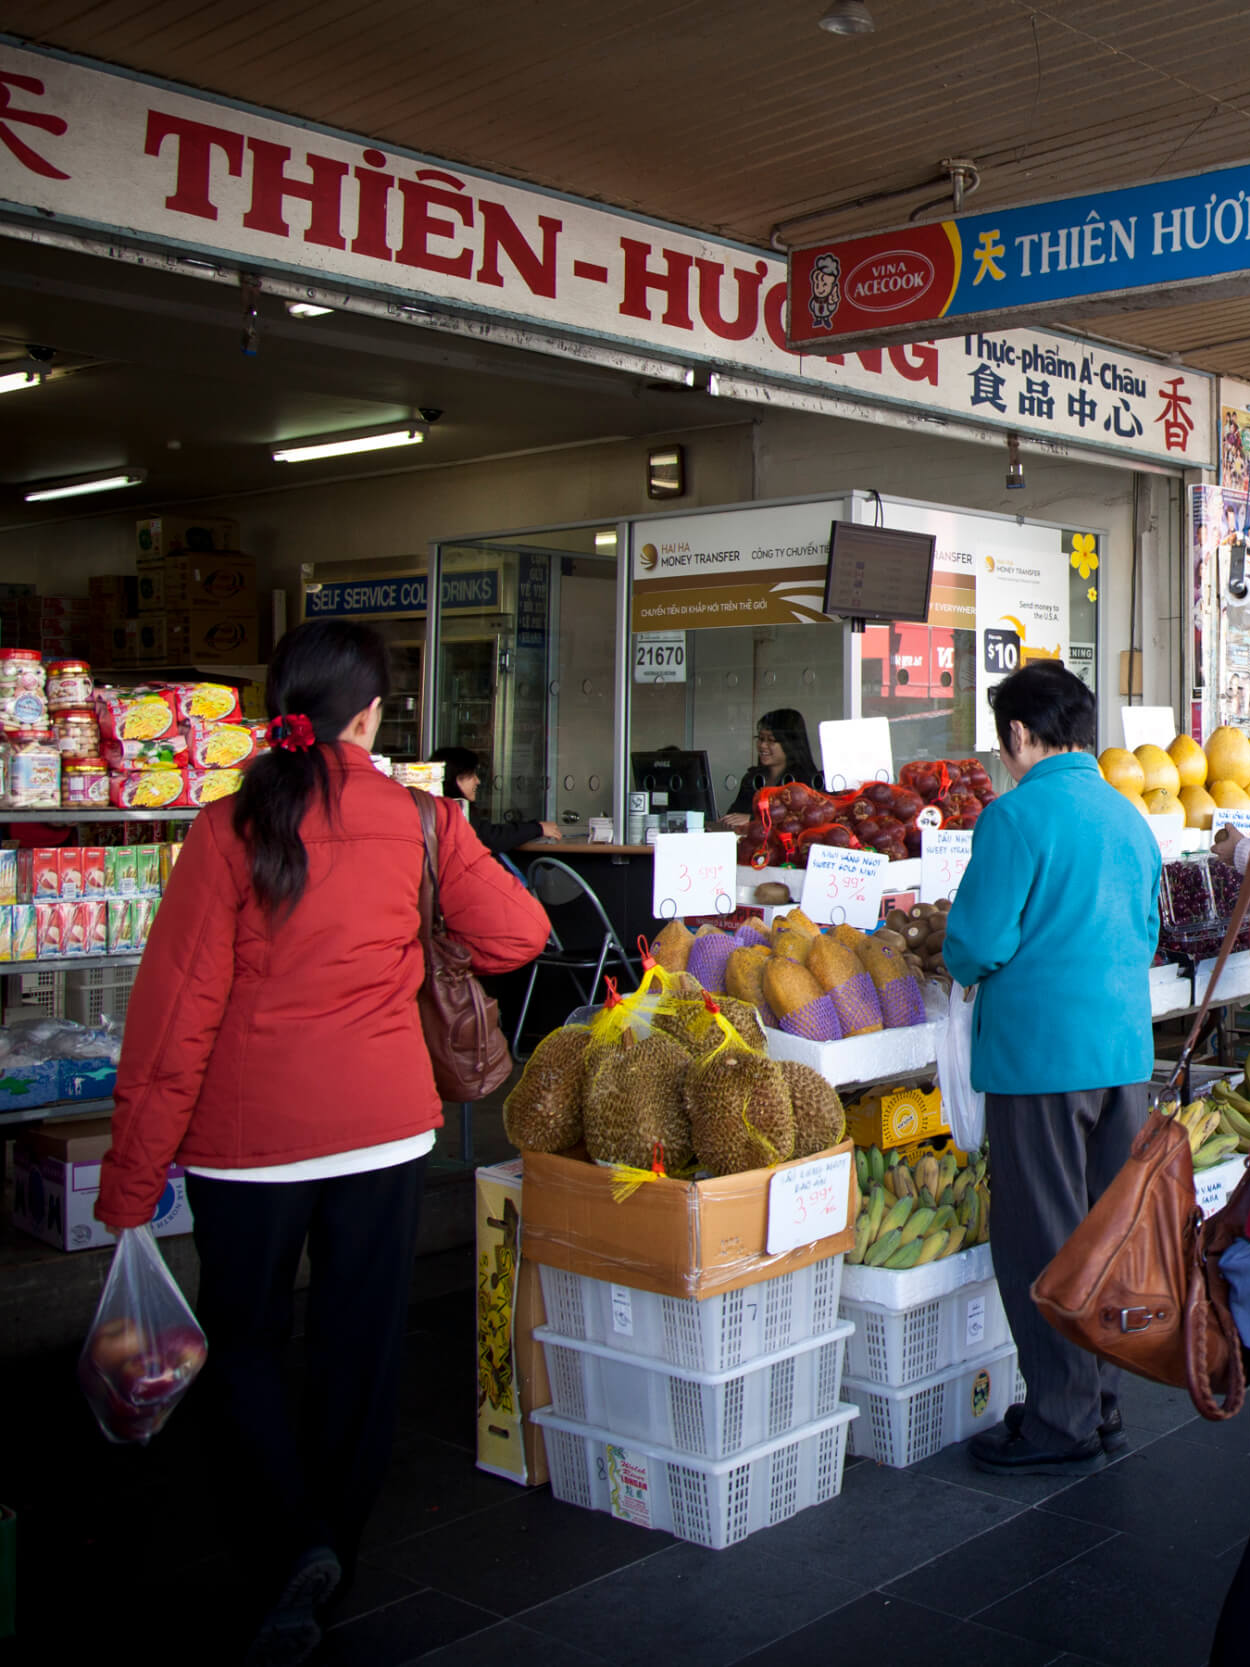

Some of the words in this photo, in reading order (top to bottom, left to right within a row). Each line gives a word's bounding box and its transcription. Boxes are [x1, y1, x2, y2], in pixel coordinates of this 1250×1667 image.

[1014, 209, 1139, 277] THIÊN
[872, 262, 907, 277] VINA
[972, 229, 1007, 287] 天
[853, 271, 925, 299] ACECOOK
[967, 362, 1144, 438] 食品中心
[1153, 376, 1195, 453] 香
[661, 543, 676, 554] HAI
[678, 542, 690, 553] HA
[661, 553, 692, 568] MONEY
[695, 550, 740, 563] TRANSFER
[312, 589, 340, 612] SELF
[343, 584, 397, 609] SERVICE
[401, 580, 430, 605] COL
[637, 646, 684, 666] 21670
[988, 643, 1017, 669] $10
